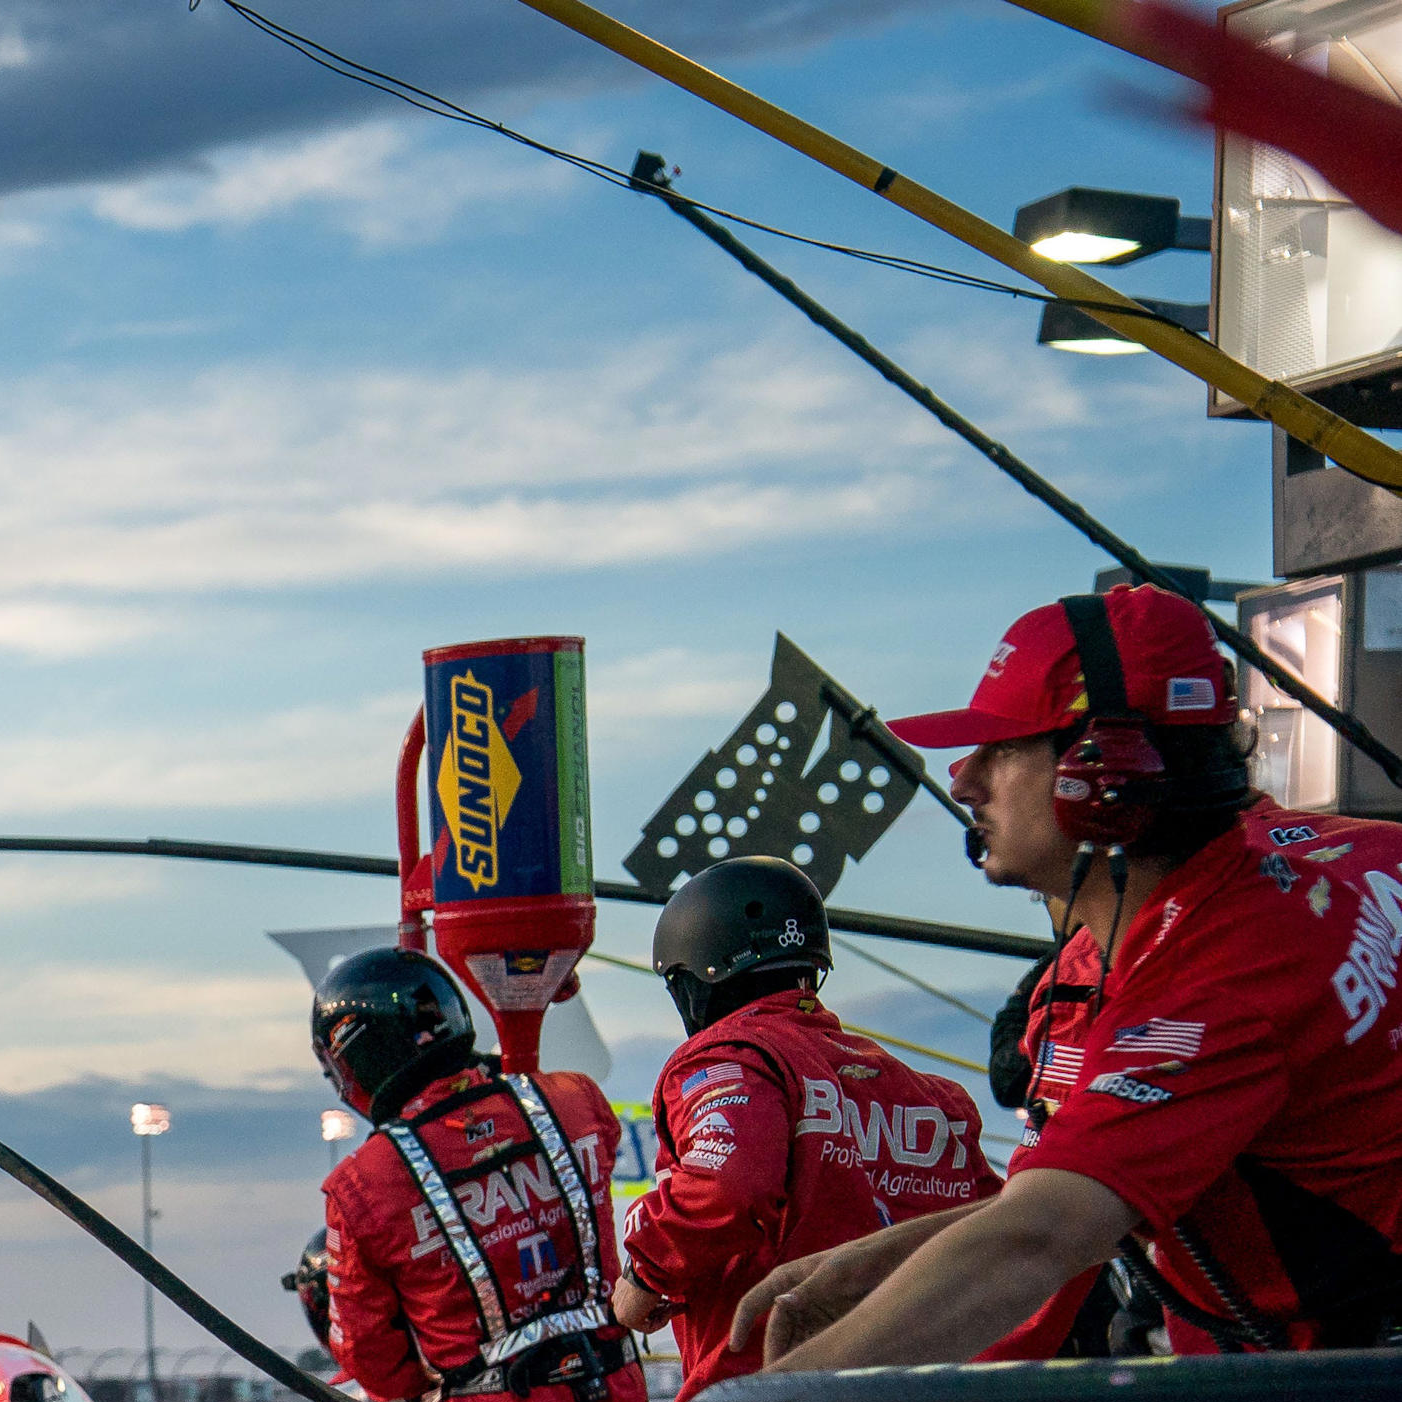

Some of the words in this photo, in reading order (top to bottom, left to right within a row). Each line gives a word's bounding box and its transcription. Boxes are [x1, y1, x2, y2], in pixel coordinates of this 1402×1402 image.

[454, 682, 495, 879] SUNOCO
[695, 1095, 750, 1118] NASCAR
[878, 1170, 971, 1198] Agriculture
